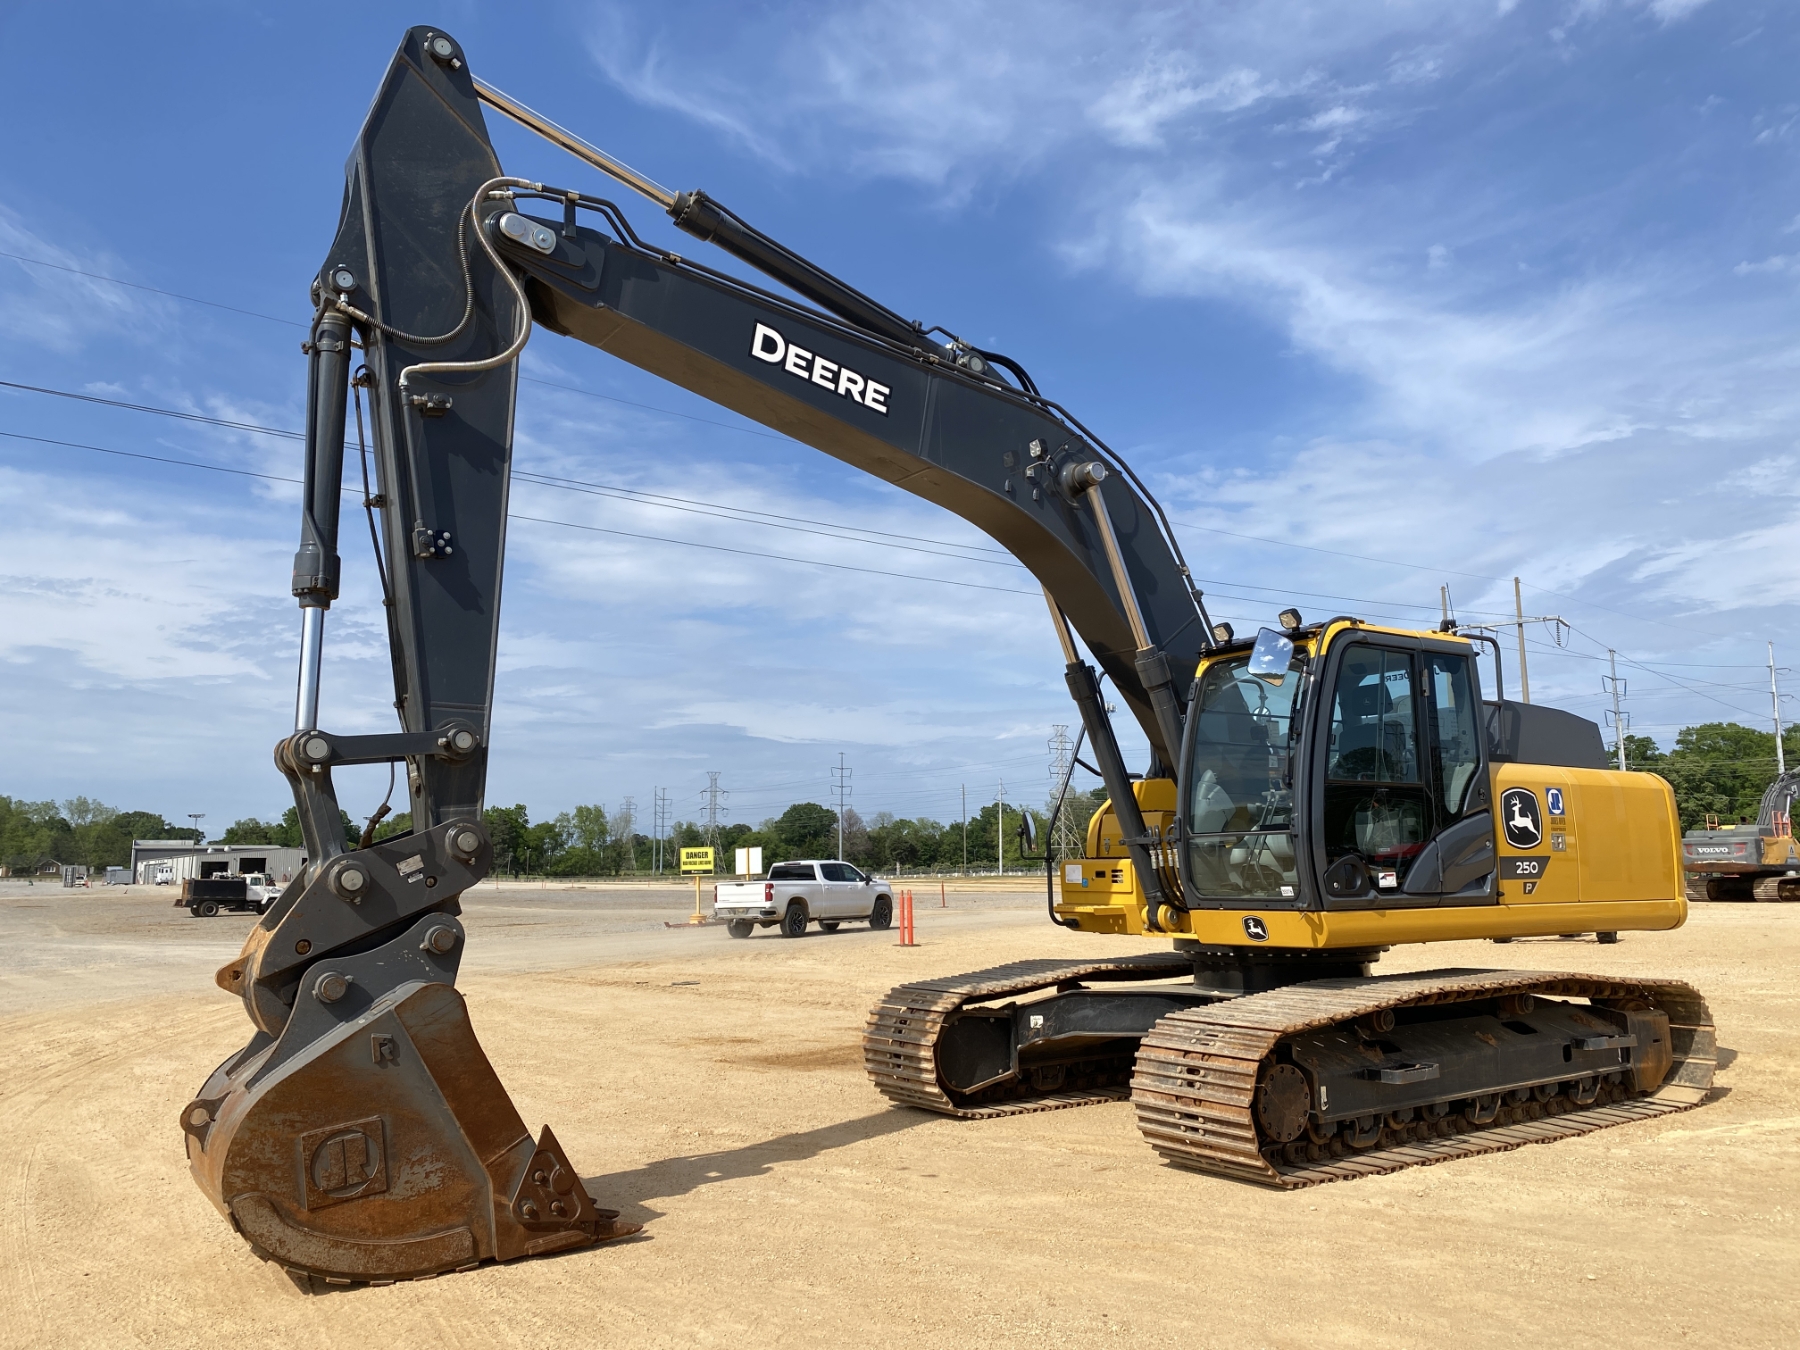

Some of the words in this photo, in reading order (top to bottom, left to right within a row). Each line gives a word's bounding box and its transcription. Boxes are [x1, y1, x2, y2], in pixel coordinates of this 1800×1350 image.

[751, 322, 890, 414] DEERE
[685, 851, 709, 859] DANGER
[1515, 861, 1539, 874] 250
[1525, 882, 1533, 893] P
